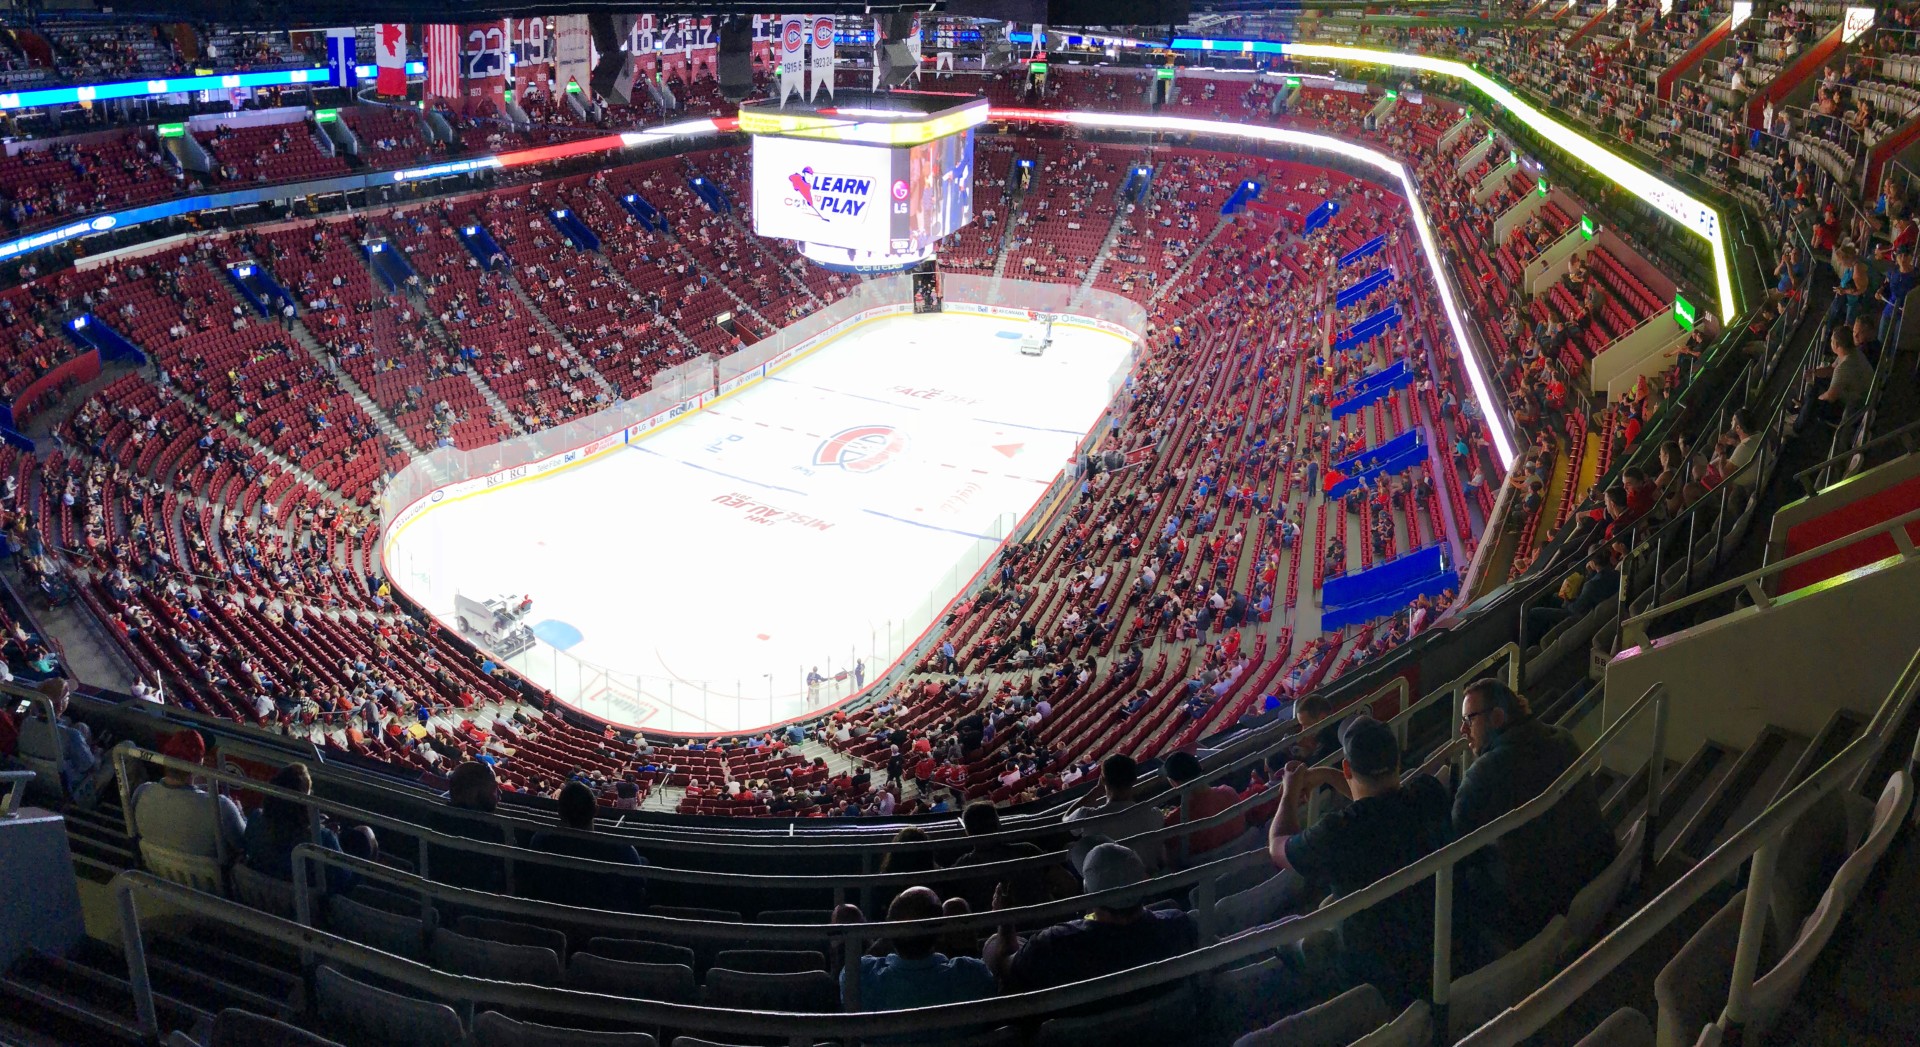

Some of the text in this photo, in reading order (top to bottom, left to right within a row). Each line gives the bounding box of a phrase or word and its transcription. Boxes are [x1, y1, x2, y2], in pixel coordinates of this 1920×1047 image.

[518, 17, 545, 67] 19
[630, 14, 653, 56] 18
[469, 27, 503, 79] 23
[812, 175, 871, 196] LEARN
[820, 196, 865, 216] PLAY
[894, 203, 908, 214] LG
[977, 305, 988, 313] Bell
[886, 385, 941, 400] FACE
[669, 401, 694, 418] ROA
[564, 451, 576, 463] Bell
[711, 495, 756, 509] JEU
[746, 505, 784, 518] AU
